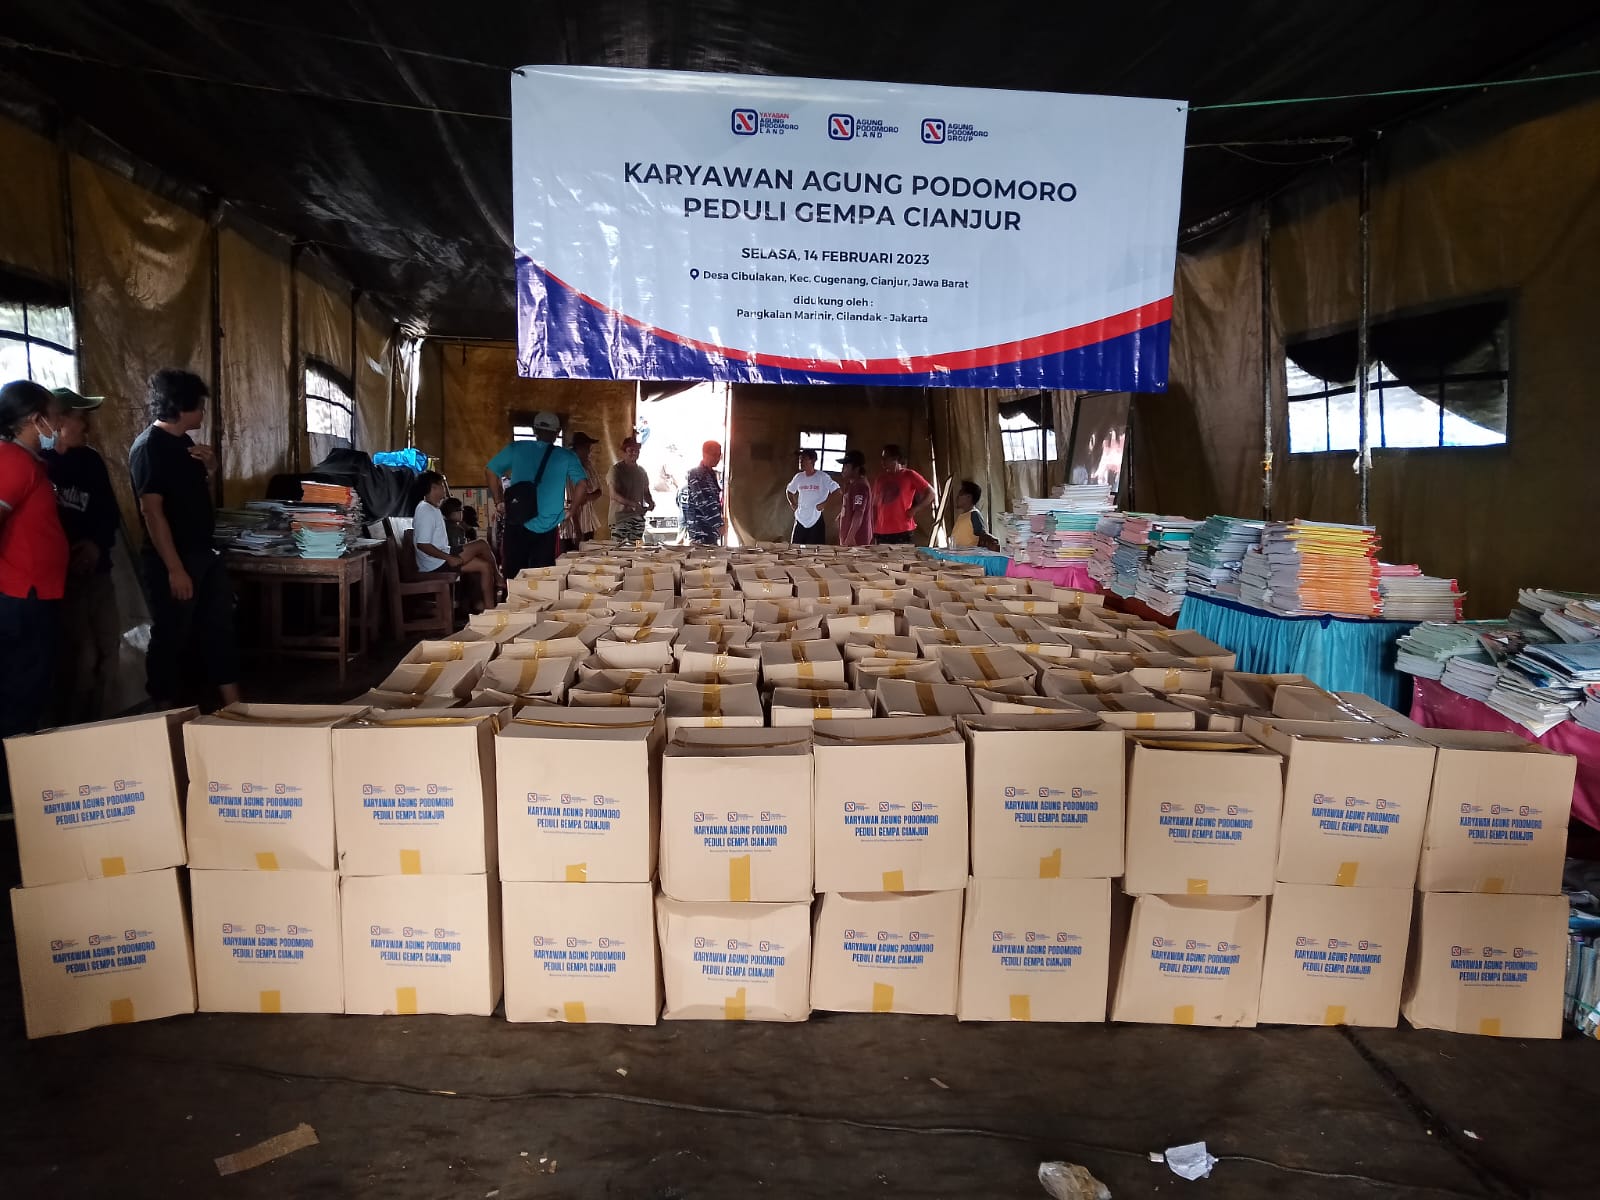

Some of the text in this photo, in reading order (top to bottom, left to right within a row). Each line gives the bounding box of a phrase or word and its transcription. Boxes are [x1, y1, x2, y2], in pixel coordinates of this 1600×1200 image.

[856, 125, 899, 133] PODOMORO
[948, 129, 988, 137] PODOMORO
[624, 162, 1077, 201] KARYAWAN AGUNG PODOMORO
[684, 197, 1021, 230] PEDULI GEMPA CIANJUR
[741, 247, 930, 265] SELASA, 14 FEBRUARI 2023
[703, 270, 969, 288] Desa Cibulakan, Kec. Cugenang, Cianjur, Jawa Barat
[793, 295, 844, 307] didukung
[845, 297, 869, 307] oleh
[736, 308, 793, 319] Pangkalan
[794, 310, 835, 320] Marinir,
[836, 311, 882, 321] Cilandak
[889, 313, 928, 323] Jakarta
[44, 791, 144, 814] KARYAWAN AGUNG PODOMORO
[208, 795, 303, 807] KARYAWAN AGUNG PODOMORO
[363, 798, 454, 807] KARYAWAN AGUNG PODOMORO
[1004, 800, 1098, 811] KARYAWAN AGUNG PODOMORO
[55, 813, 80, 825] PEDULI
[79, 809, 106, 822] GEMPA
[104, 805, 136, 818] CIANJUR
[218, 807, 292, 820] PEDULI GEMPA CIANJUR
[373, 810, 445, 820] PEDULI GEMPA CIANJUR
[527, 806, 620, 818] KARYAWAN AGUNG PODOMORO
[1014, 812, 1088, 823] PEDULI GEMPA CIANJUR
[1311, 807, 1400, 823] KARYAWAN AGUNG PODOMORO
[537, 818, 611, 830] PEDULI GEMPA CIANJUR
[844, 815, 939, 825] KARYAWAN AGUNG PODOMORO
[1159, 816, 1253, 828] KARYAWAN AGUNG PODOMORO
[1459, 817, 1542, 829] KARYAWAN AGUNG PODOMORO
[693, 825, 788, 834] KARYAWAN AGUNG PODOMORO
[855, 827, 929, 836] PEDULI GEMPA CIANJUR
[1319, 819, 1389, 834] PEDULI GEMPA CIANJUR
[1168, 827, 1242, 840] PEDULI GEMPA CIANJUR
[1467, 829, 1534, 840] PEDULI GEMPA CIANJUR
[703, 837, 777, 847] PEDULI GEMPA CIANJUR
[223, 937, 314, 948] KARYAWAN AGUNG PODOMORO
[370, 939, 461, 951] KARYAWAN AGUNG PODOMORO
[843, 942, 934, 953] KARYAWAN AGUNG PODOMORO
[52, 941, 156, 964] KARYAWAN AGUNG PODOMORO
[232, 948, 304, 959] PEDULI GEMPA CIANJUR
[533, 950, 626, 960] KARYAWAN AGUNG PODOMORO
[991, 945, 1082, 955] KARYAWAN AGUNG PODOMORO
[380, 951, 452, 963] PEDULI GEMPA CIANJUR
[693, 952, 784, 966] KARYAWAN AGUNG PODOMORO
[851, 953, 924, 964] PEDULI GEMPA CIANJUR
[1000, 955, 1072, 966] PEDULI GEMPA CIANJUR
[1151, 950, 1240, 964] KARYAWAN AGUNG PODOMORO
[1295, 950, 1382, 963] KARYAWAN AGUNG PODOMORO
[66, 961, 90, 973] PEDULI
[89, 958, 117, 971] GEMPA
[115, 954, 147, 967] CIANJUR
[543, 961, 617, 972] PEDULI GEMPA CIANJUR
[1159, 962, 1230, 975] PEDULI GEMPA CIANJUR
[1302, 961, 1371, 975] PEDULI GEMPA CIANJUR
[1450, 959, 1537, 971] KARYAWAN AGUNG PODOMORO
[702, 964, 775, 978] PEDULI GEMPA CIANJUR
[1459, 971, 1528, 982] PEDULI GEMPA CIANJUR
